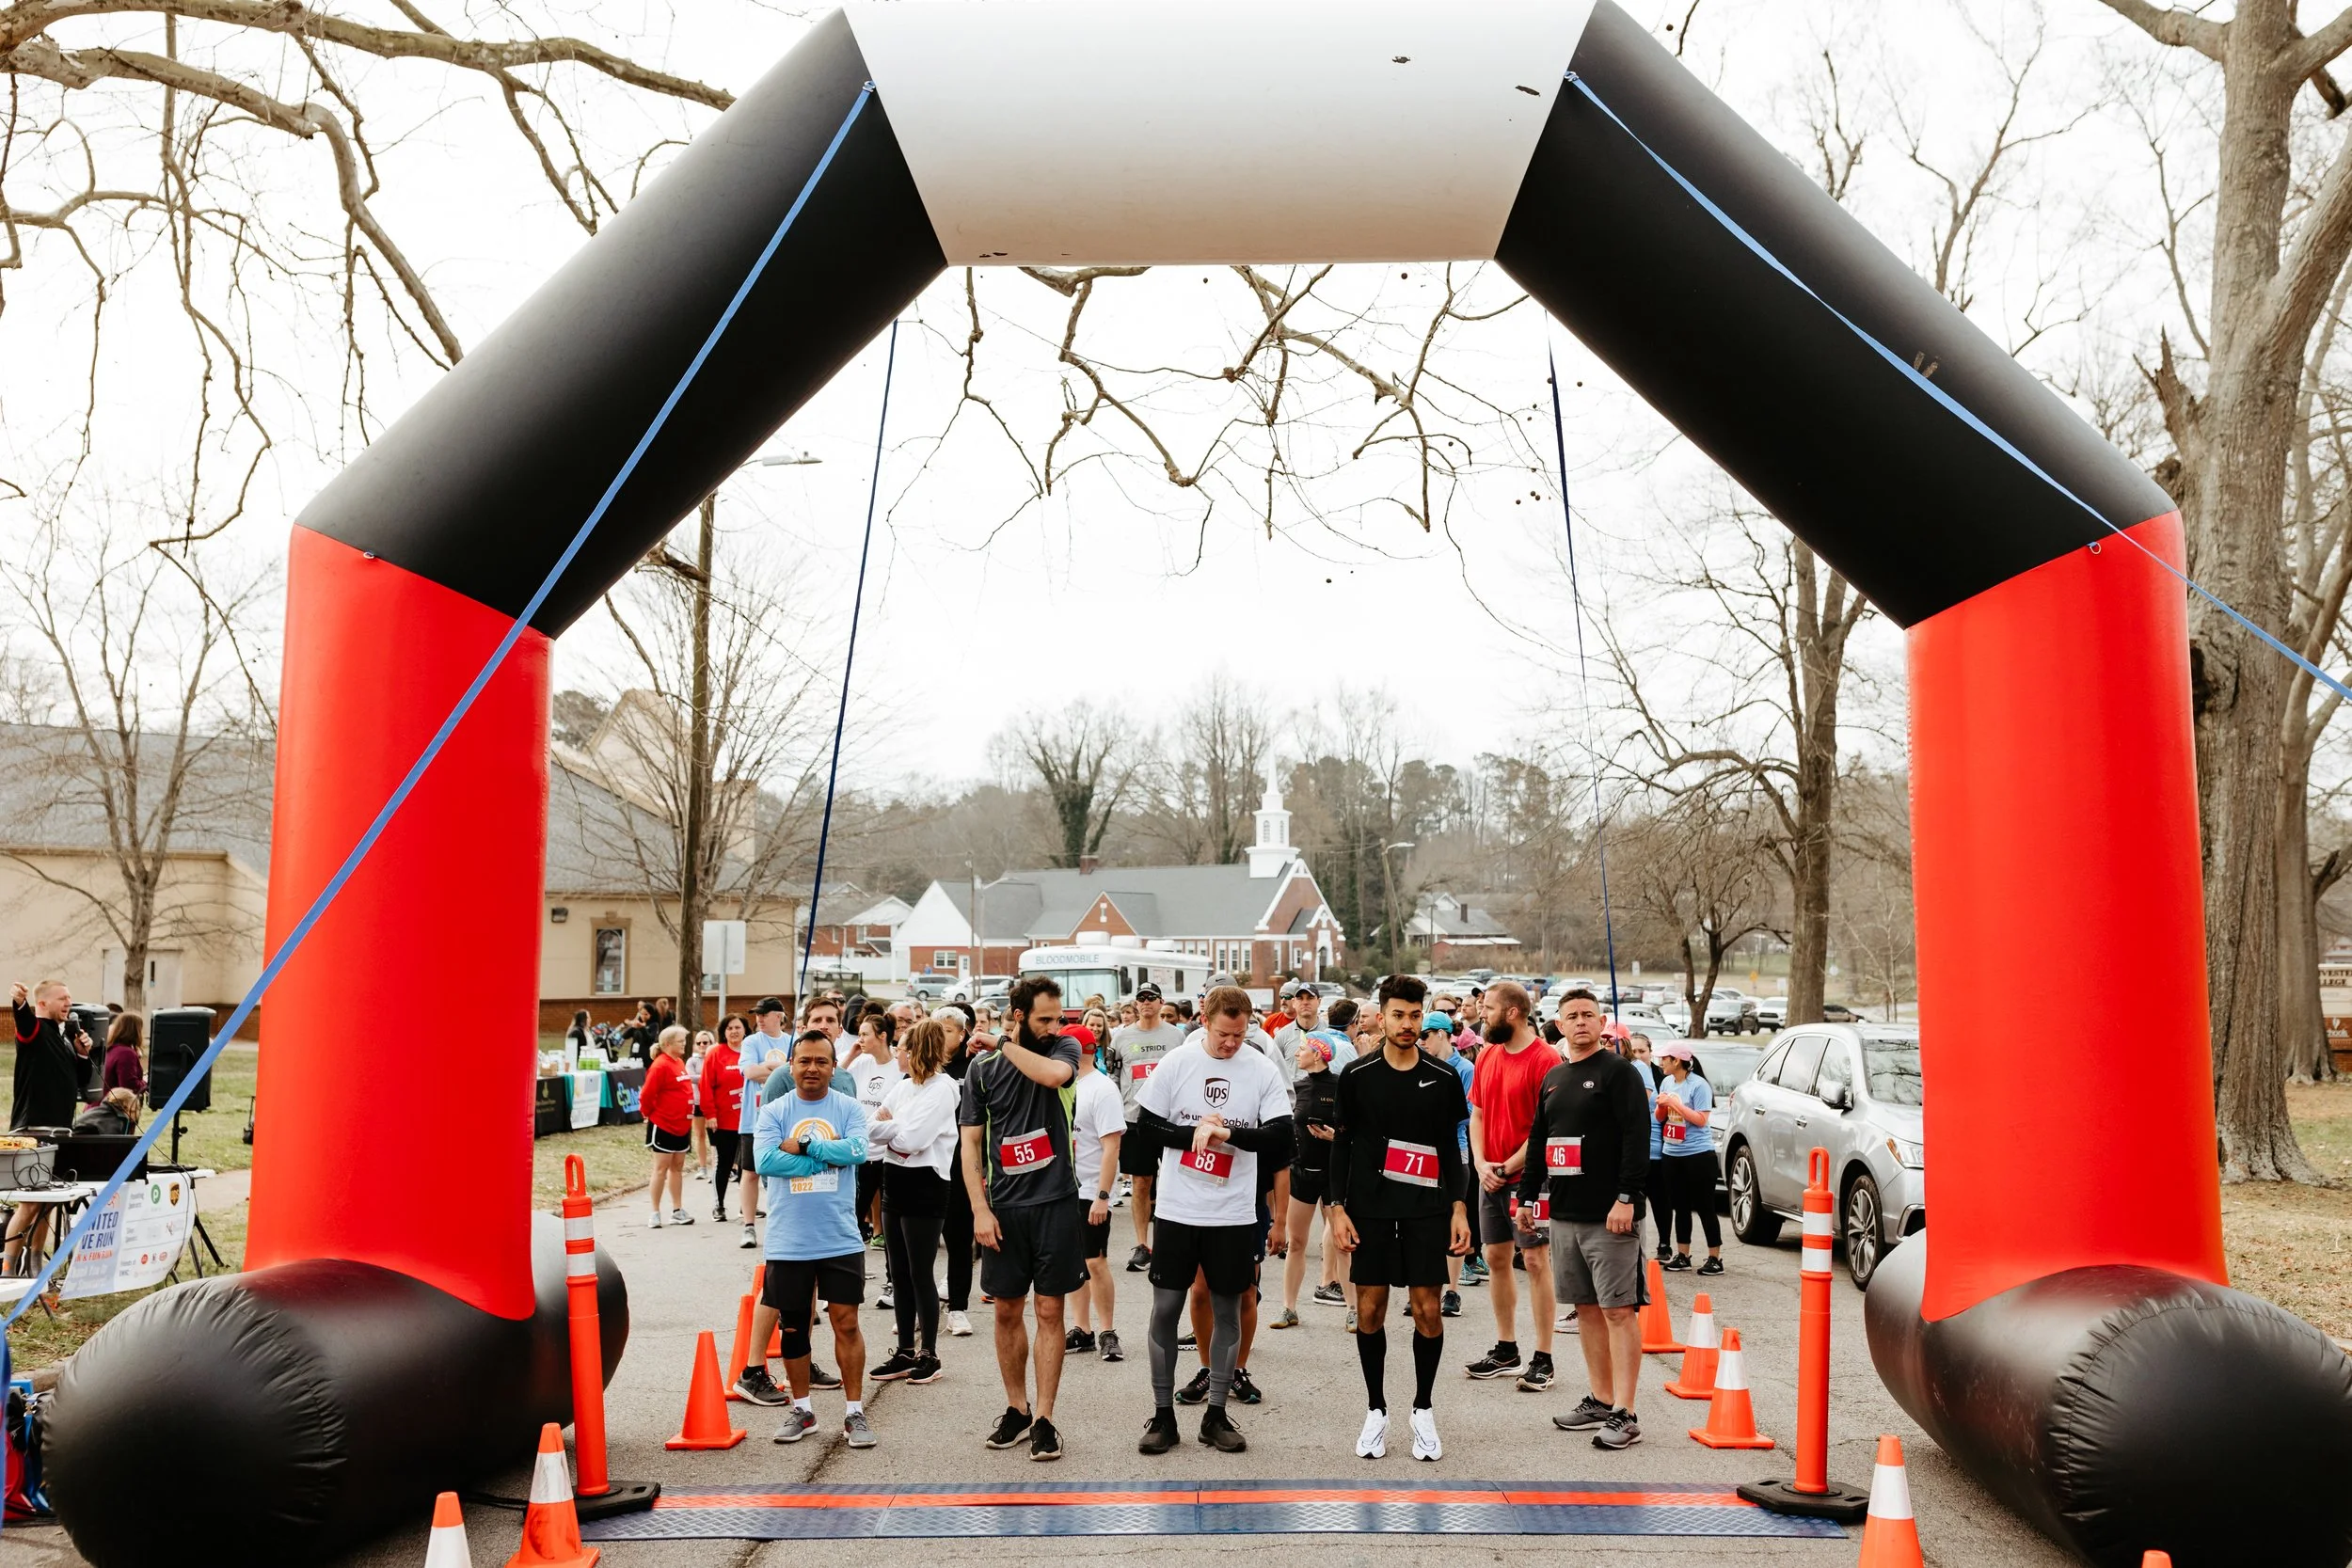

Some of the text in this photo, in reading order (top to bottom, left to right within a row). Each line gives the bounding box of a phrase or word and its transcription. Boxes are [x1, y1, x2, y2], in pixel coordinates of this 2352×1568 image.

[1036, 954, 1100, 965] BLOODMOBILE
[1140, 1044, 1167, 1053] STRIDE
[868, 1082, 882, 1091] ups
[1206, 1086, 1227, 1102] ups
[861, 1099, 882, 1107] nstopp
[1666, 1125, 1676, 1137] 21
[1013, 1143, 1036, 1164] 55
[1552, 1147, 1565, 1165] 46
[1195, 1153, 1216, 1172] 68
[1404, 1152, 1424, 1175] 71
[792, 1182, 813, 1192] 2022
[1533, 1201, 1540, 1218] 0
[87, 1212, 119, 1230] NITED
[96, 1231, 114, 1248] RUN
